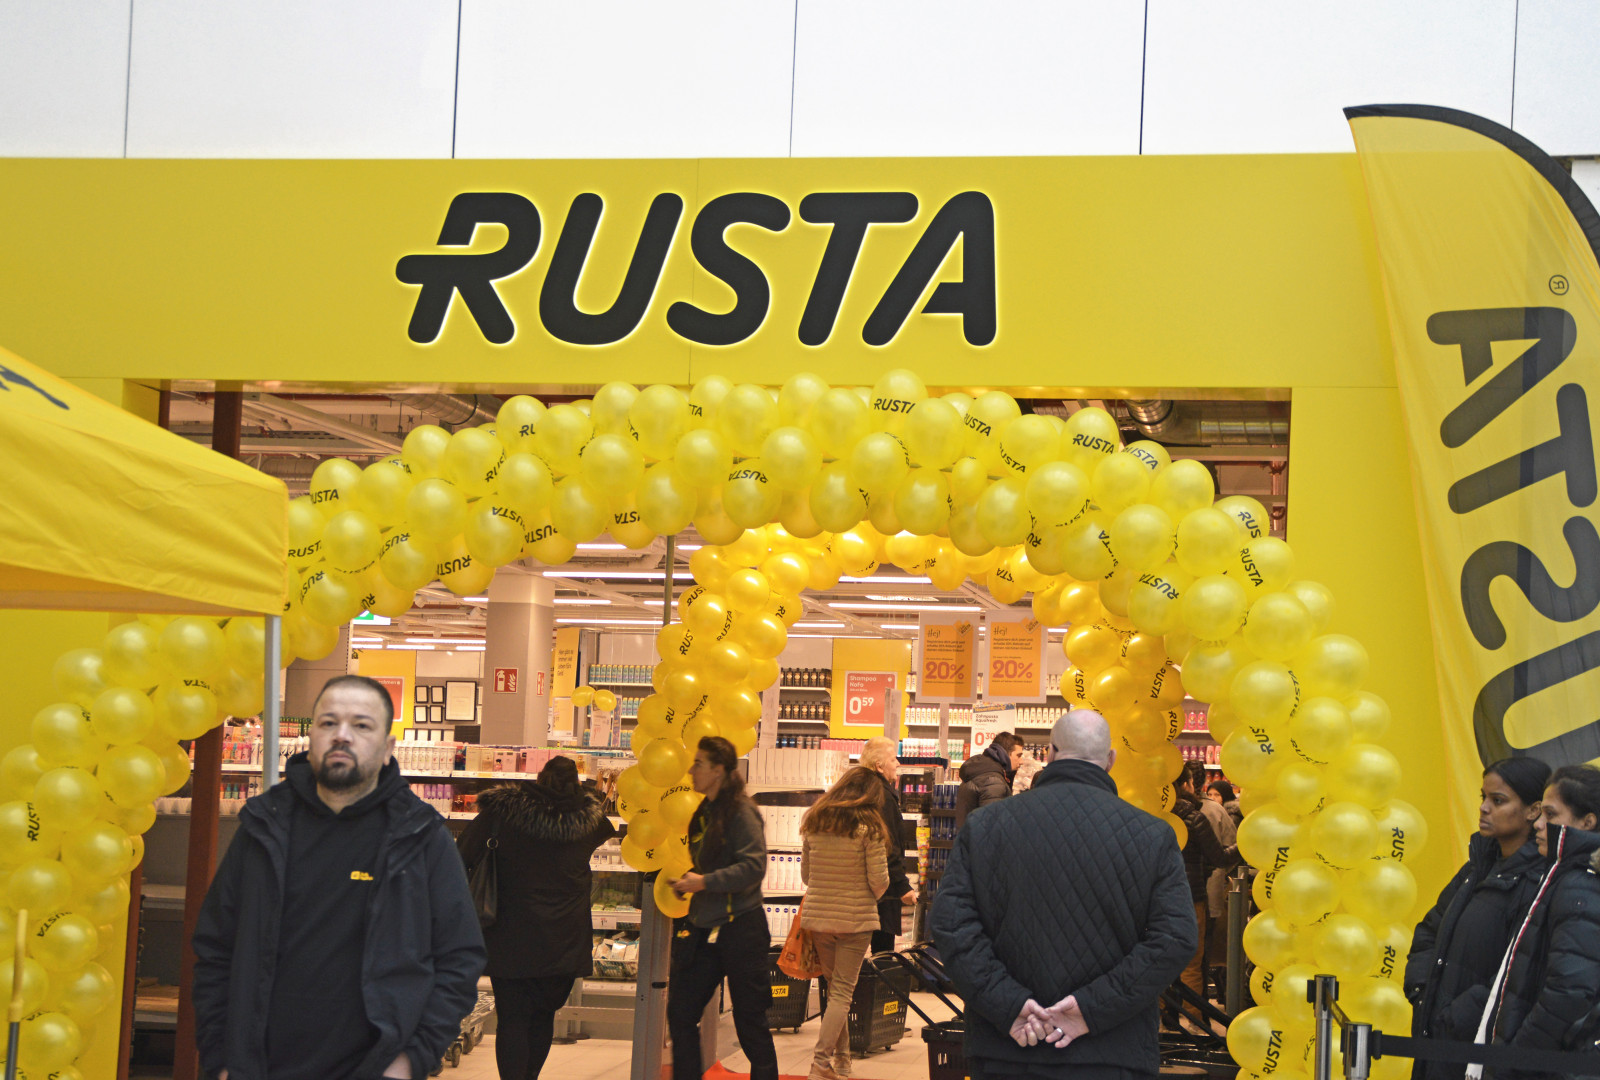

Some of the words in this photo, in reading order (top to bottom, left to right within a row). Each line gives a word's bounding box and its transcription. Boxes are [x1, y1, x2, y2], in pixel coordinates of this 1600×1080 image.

[396, 191, 997, 346] RUSTA
[1073, 434, 1114, 454] RUSTA
[729, 470, 768, 483] RUSTA
[1238, 512, 1261, 538] RUS
[1241, 548, 1263, 587] RUSTA
[687, 586, 706, 606] RUS
[1139, 574, 1179, 599] RUSTA
[717, 611, 732, 641] RUSTA
[680, 629, 693, 655] RUS
[925, 661, 965, 680] 20%
[992, 660, 1032, 679] 20%
[1249, 726, 1274, 755] RUS
[1391, 827, 1404, 862] RUS
[1381, 946, 1396, 978] RUS
[1263, 1030, 1283, 1074] RUSTA
